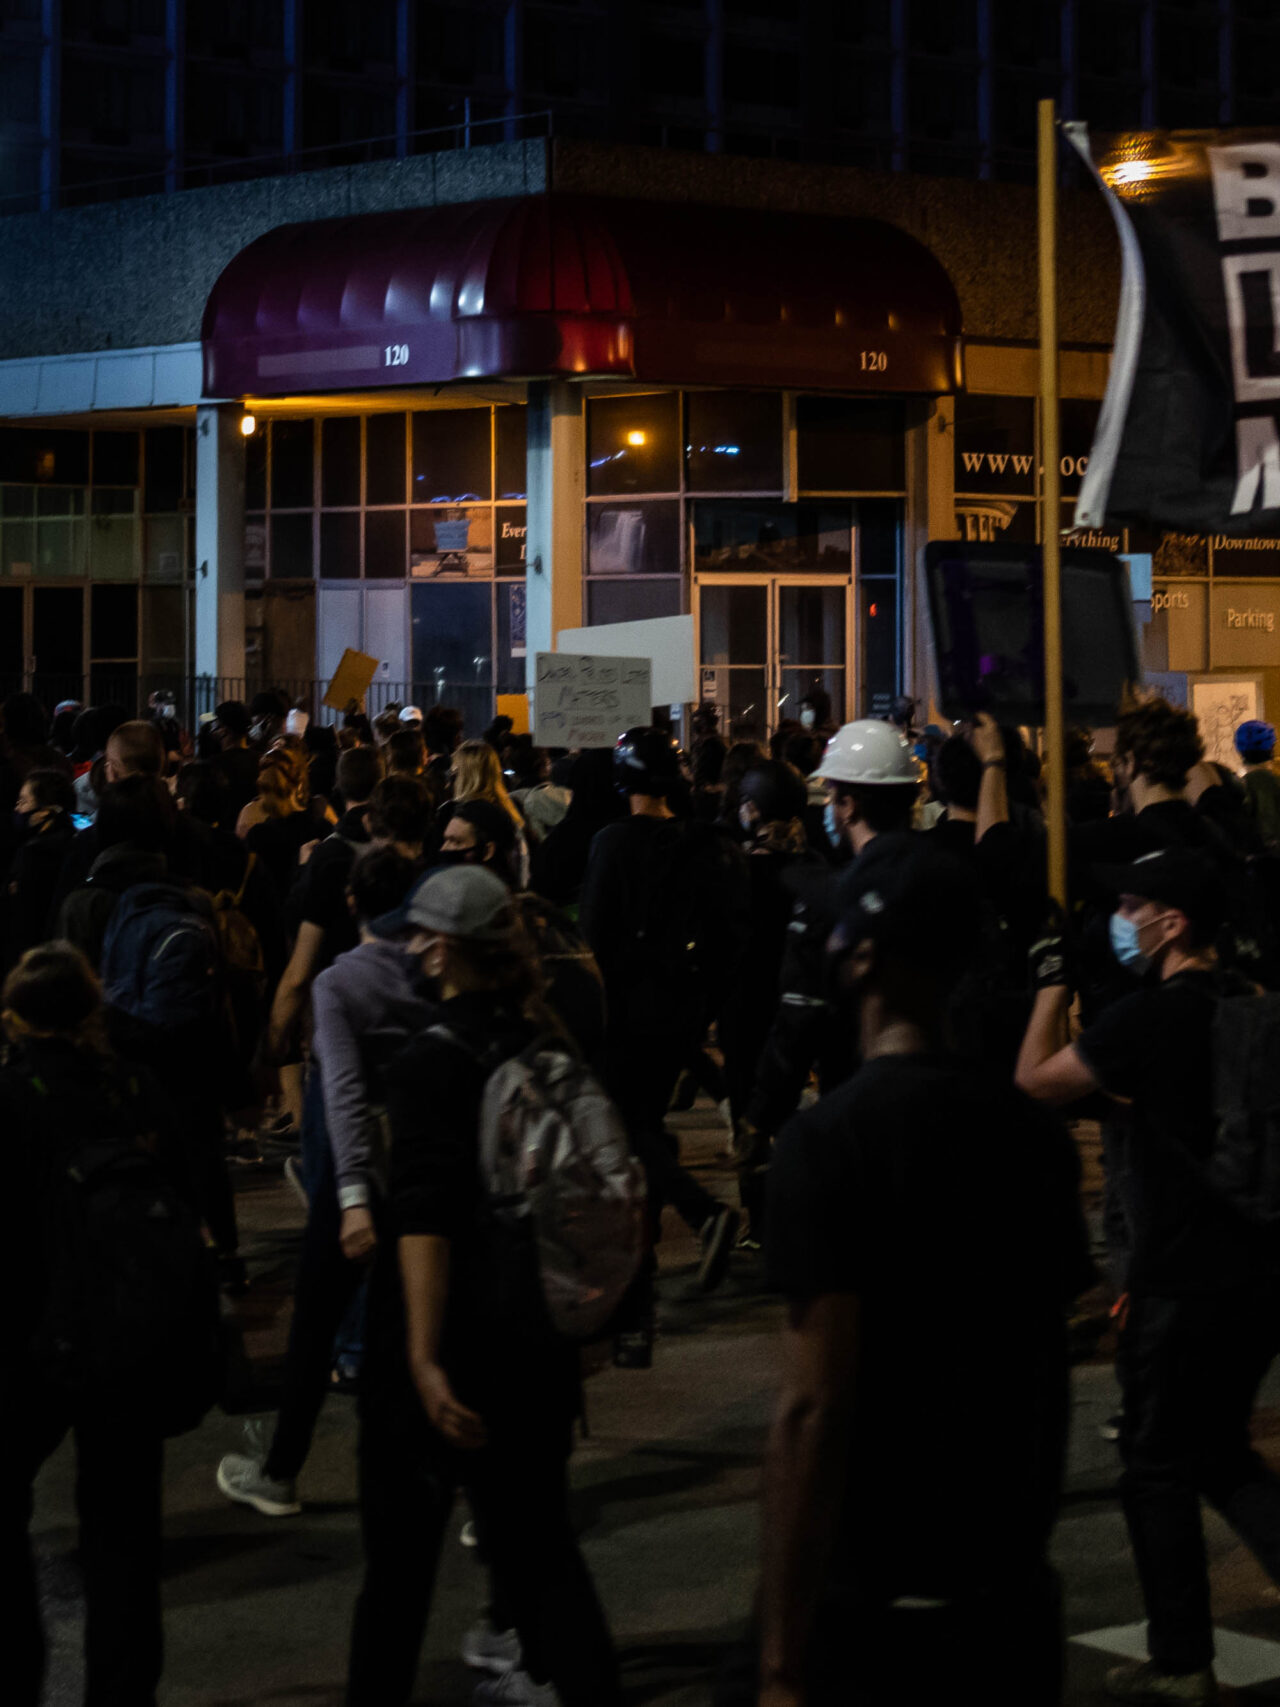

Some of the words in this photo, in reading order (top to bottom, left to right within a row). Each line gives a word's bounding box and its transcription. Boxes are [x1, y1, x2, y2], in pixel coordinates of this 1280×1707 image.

[384, 344, 410, 367] 120
[860, 351, 888, 371] 120
[1228, 608, 1274, 632] Parking
